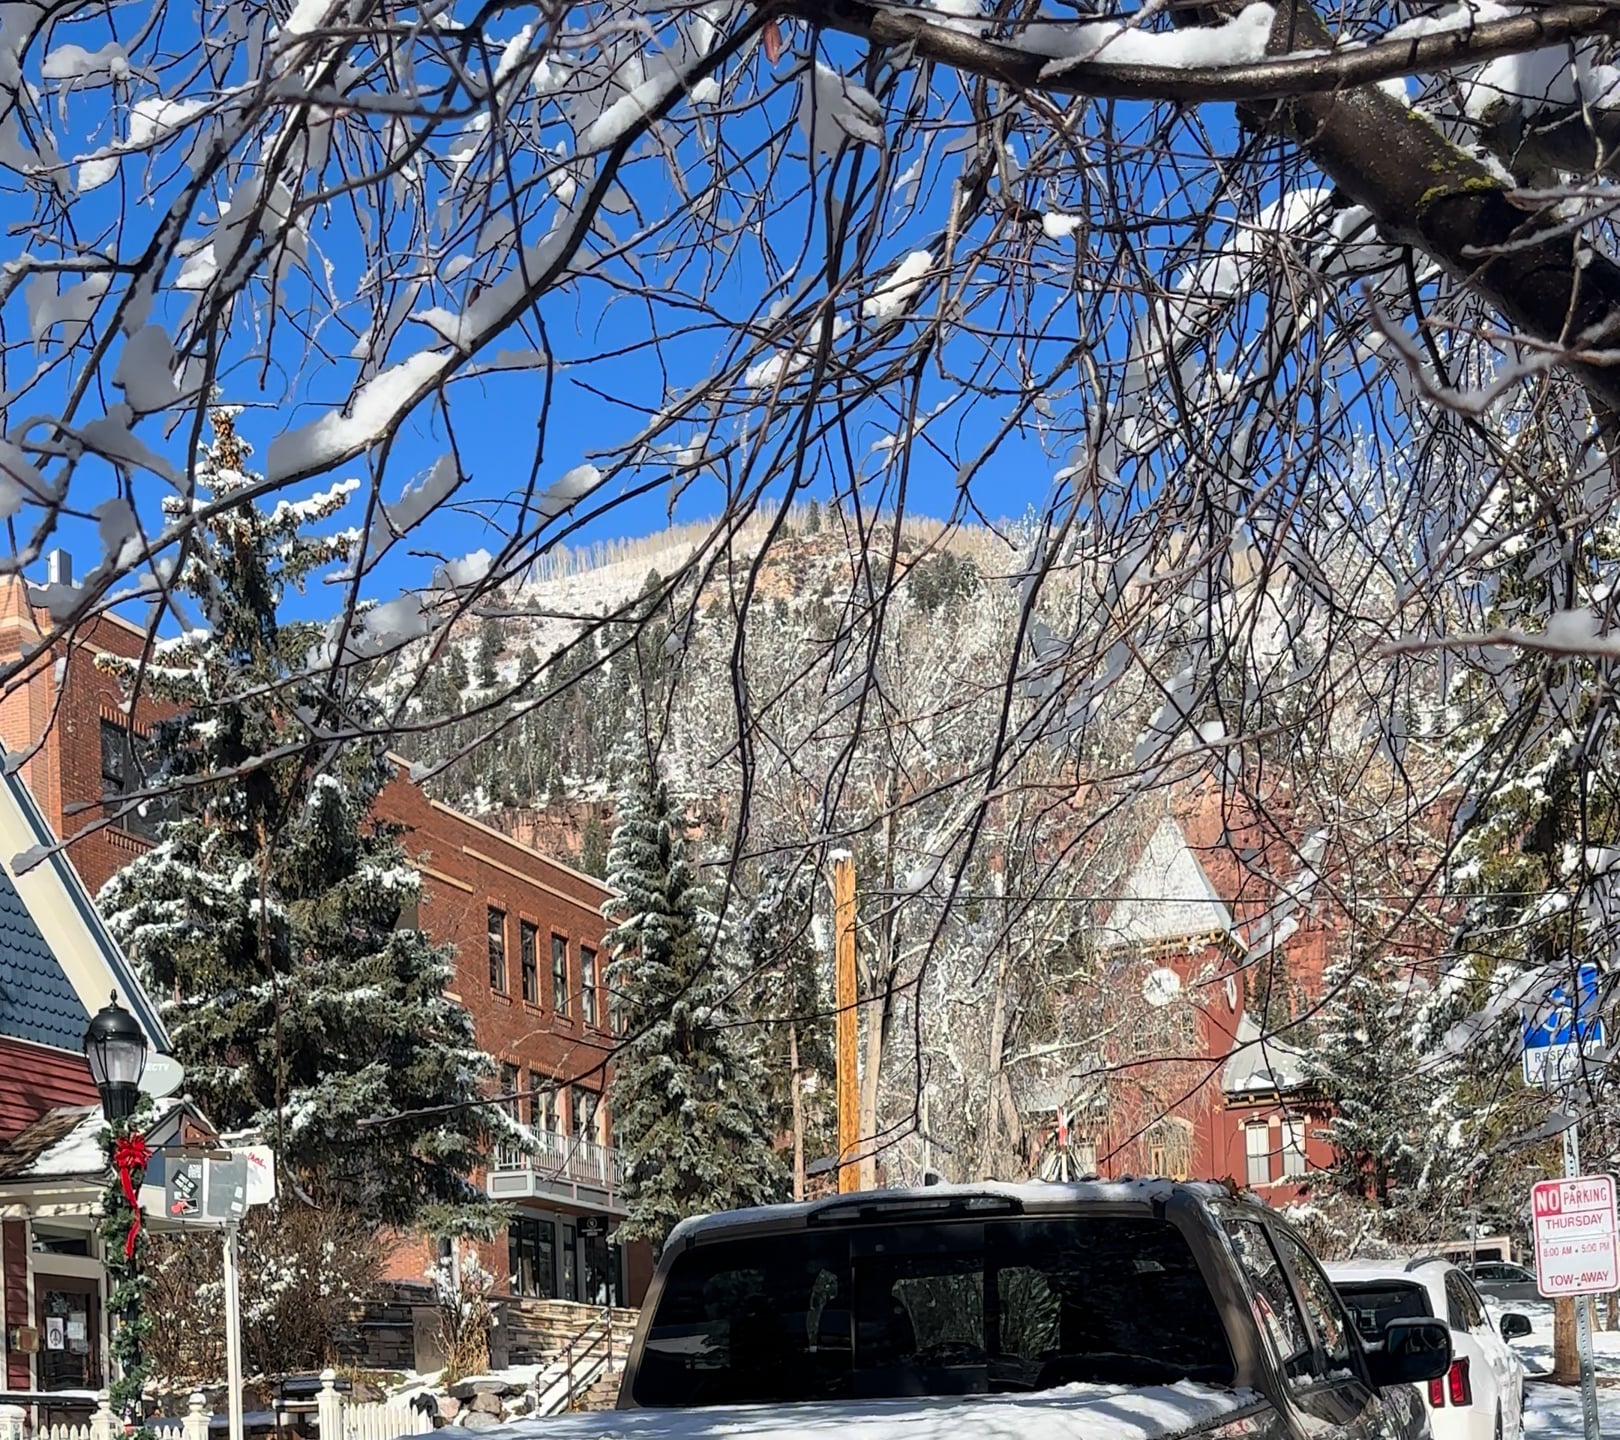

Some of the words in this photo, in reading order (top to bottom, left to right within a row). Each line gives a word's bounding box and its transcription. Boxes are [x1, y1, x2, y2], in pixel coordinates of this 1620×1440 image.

[1534, 1045, 1594, 1063] RESERVD
[1535, 1189, 1560, 1213] NO
[1563, 1187, 1607, 1206] PARKING
[1545, 1213, 1604, 1230] THURSDAY
[1543, 1247, 1560, 1258] 8:00
[1561, 1245, 1573, 1256] AM
[1581, 1243, 1597, 1254] 5:00
[1599, 1241, 1610, 1252] PM
[1548, 1271, 1609, 1287] TOW-AWAY
